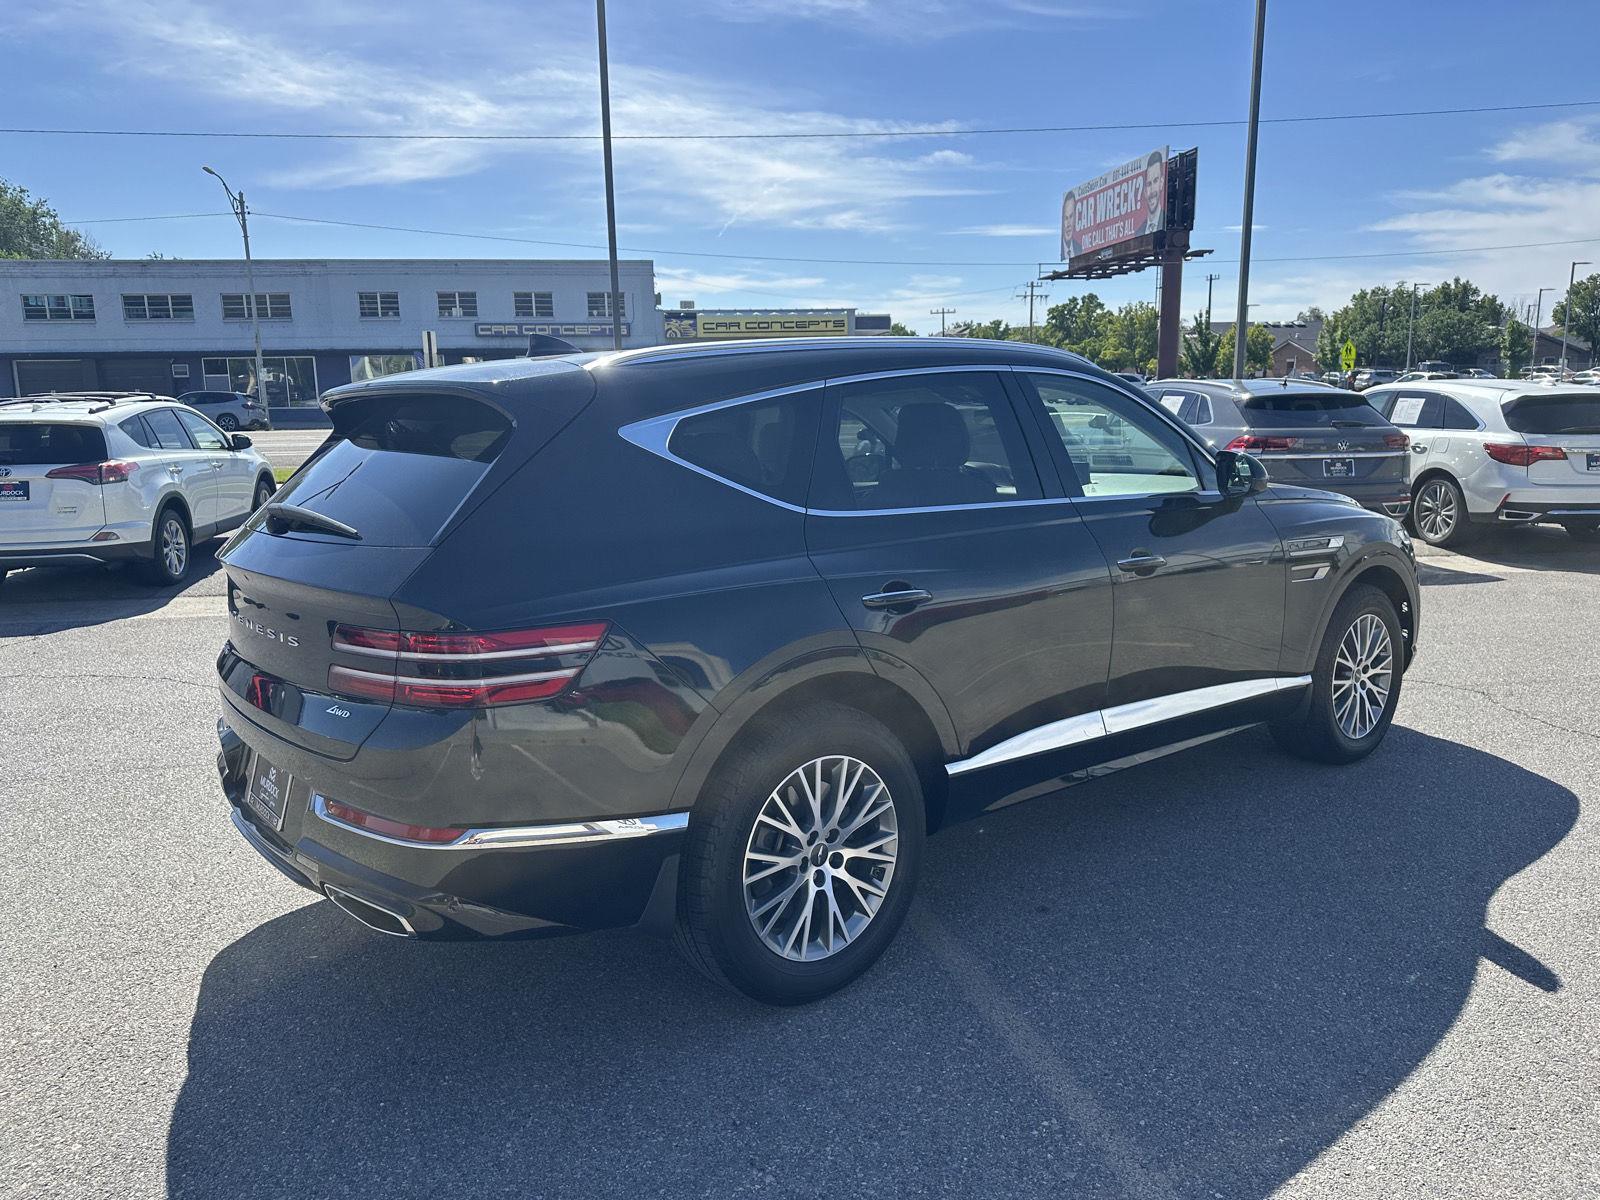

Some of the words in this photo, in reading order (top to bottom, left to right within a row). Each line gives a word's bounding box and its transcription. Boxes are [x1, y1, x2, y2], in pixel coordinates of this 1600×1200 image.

[1075, 196, 1095, 232] CAR
[1096, 175, 1144, 224] WRECK?
[1082, 232, 1092, 250] ONE
[1092, 228, 1105, 246] CALL
[1105, 221, 1124, 243] THAT'S
[1124, 217, 1135, 235] ALL
[478, 325, 519, 335] CAR
[702, 321, 741, 331] CAR
[745, 319, 846, 330] CONCEPTS
[232, 611, 300, 647] ENESIS
